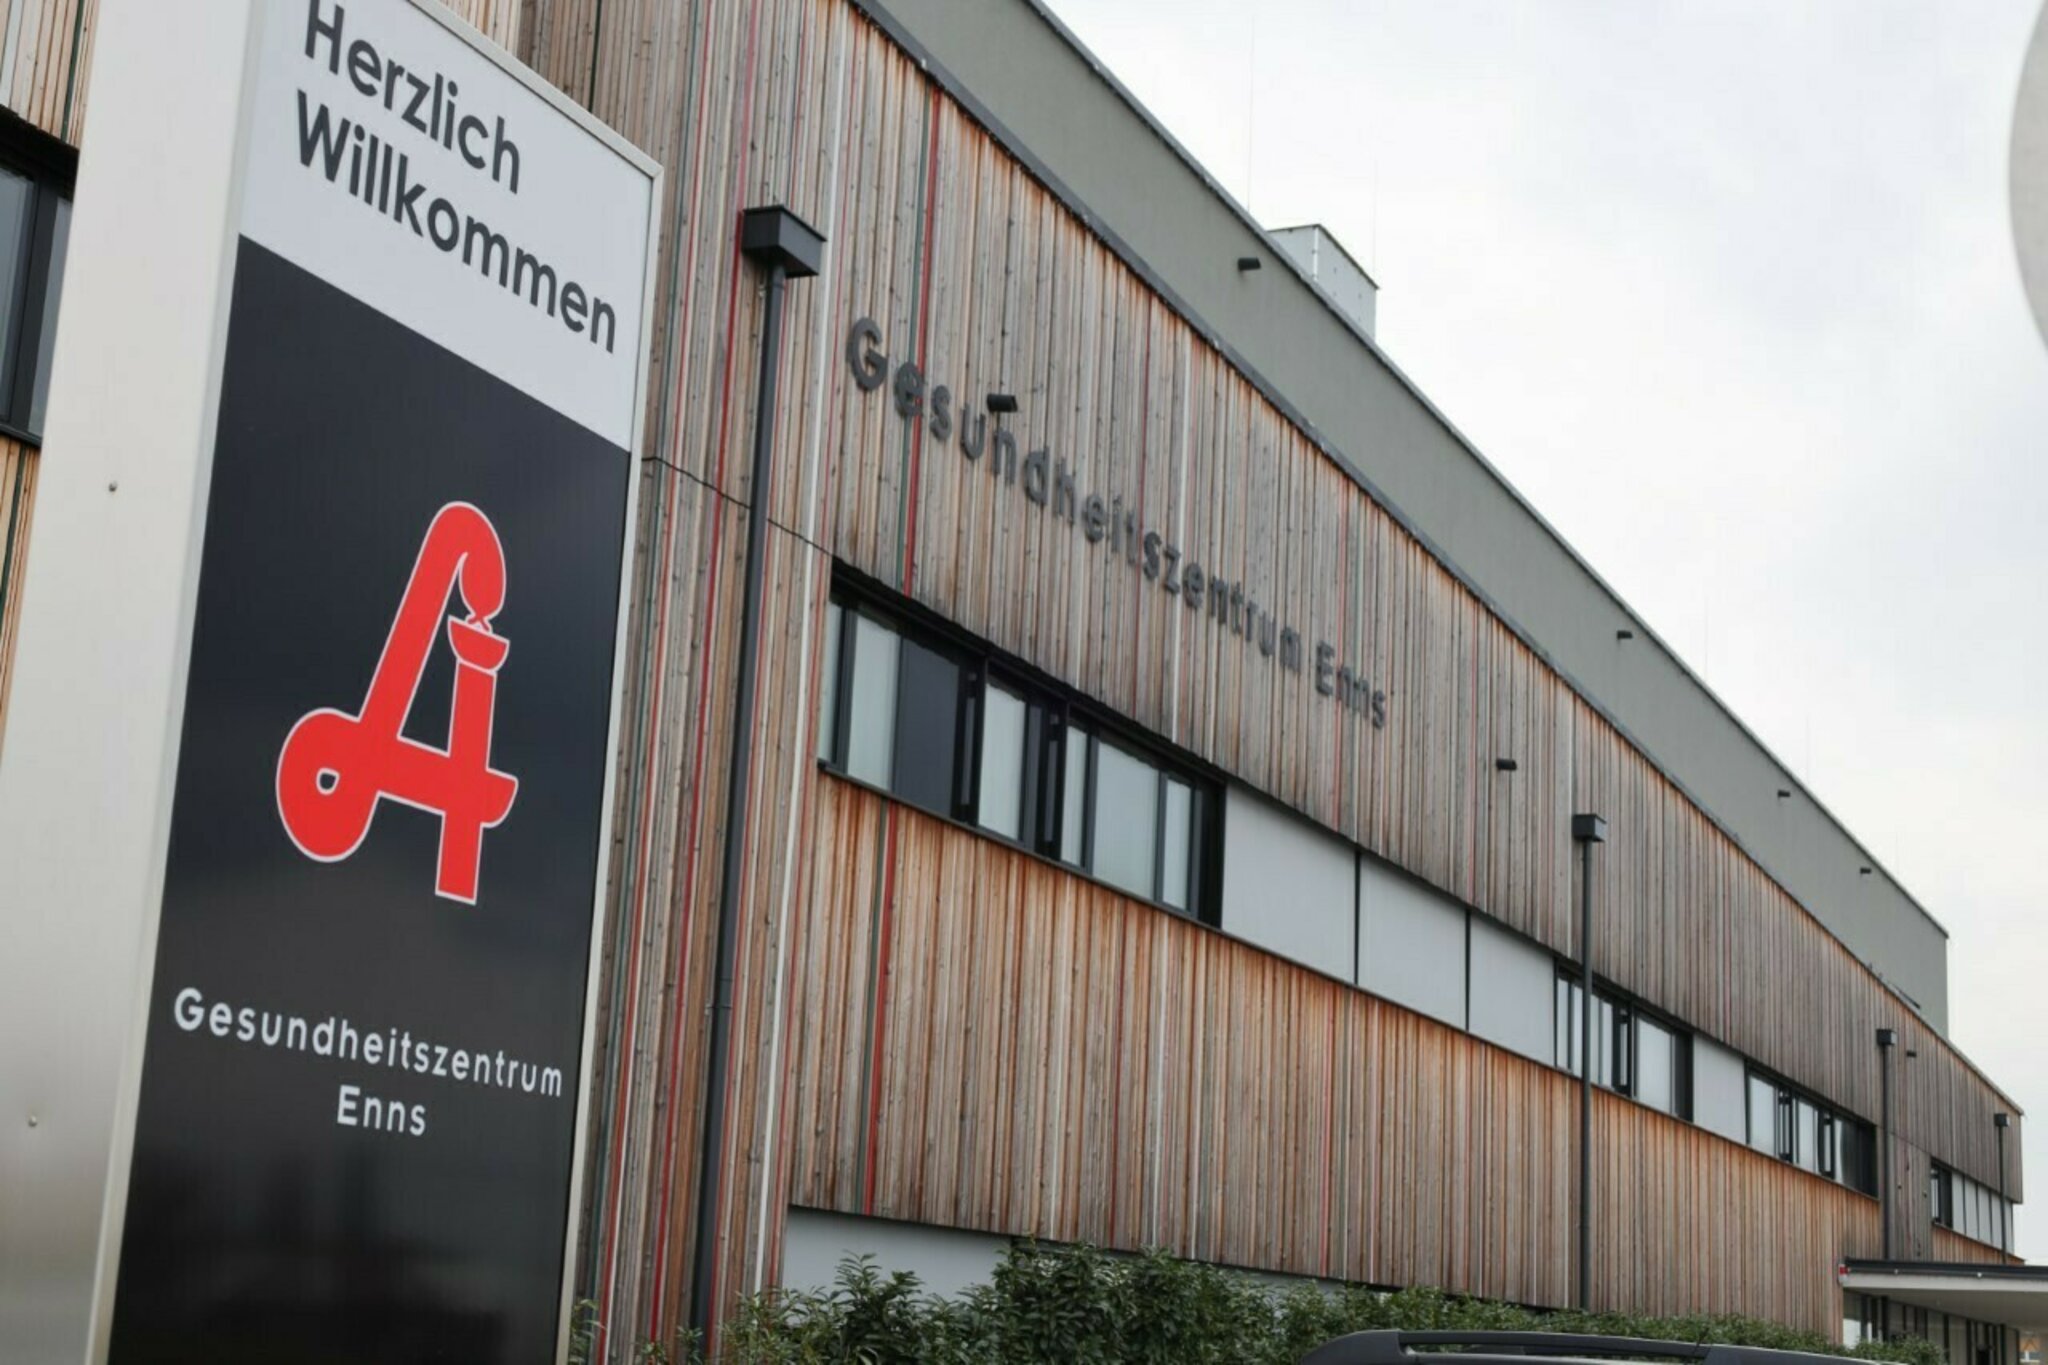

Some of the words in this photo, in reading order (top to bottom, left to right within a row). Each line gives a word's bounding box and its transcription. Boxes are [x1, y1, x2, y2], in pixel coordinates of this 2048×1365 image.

[305, 0, 520, 194] Herzlich
[297, 88, 616, 354] Willkommen
[847, 317, 1301, 673] Gesundheitszentrum
[1315, 641, 1386, 729] Enns
[174, 987, 562, 1097] Gesundheitszentrum
[337, 1084, 426, 1136] Enns
